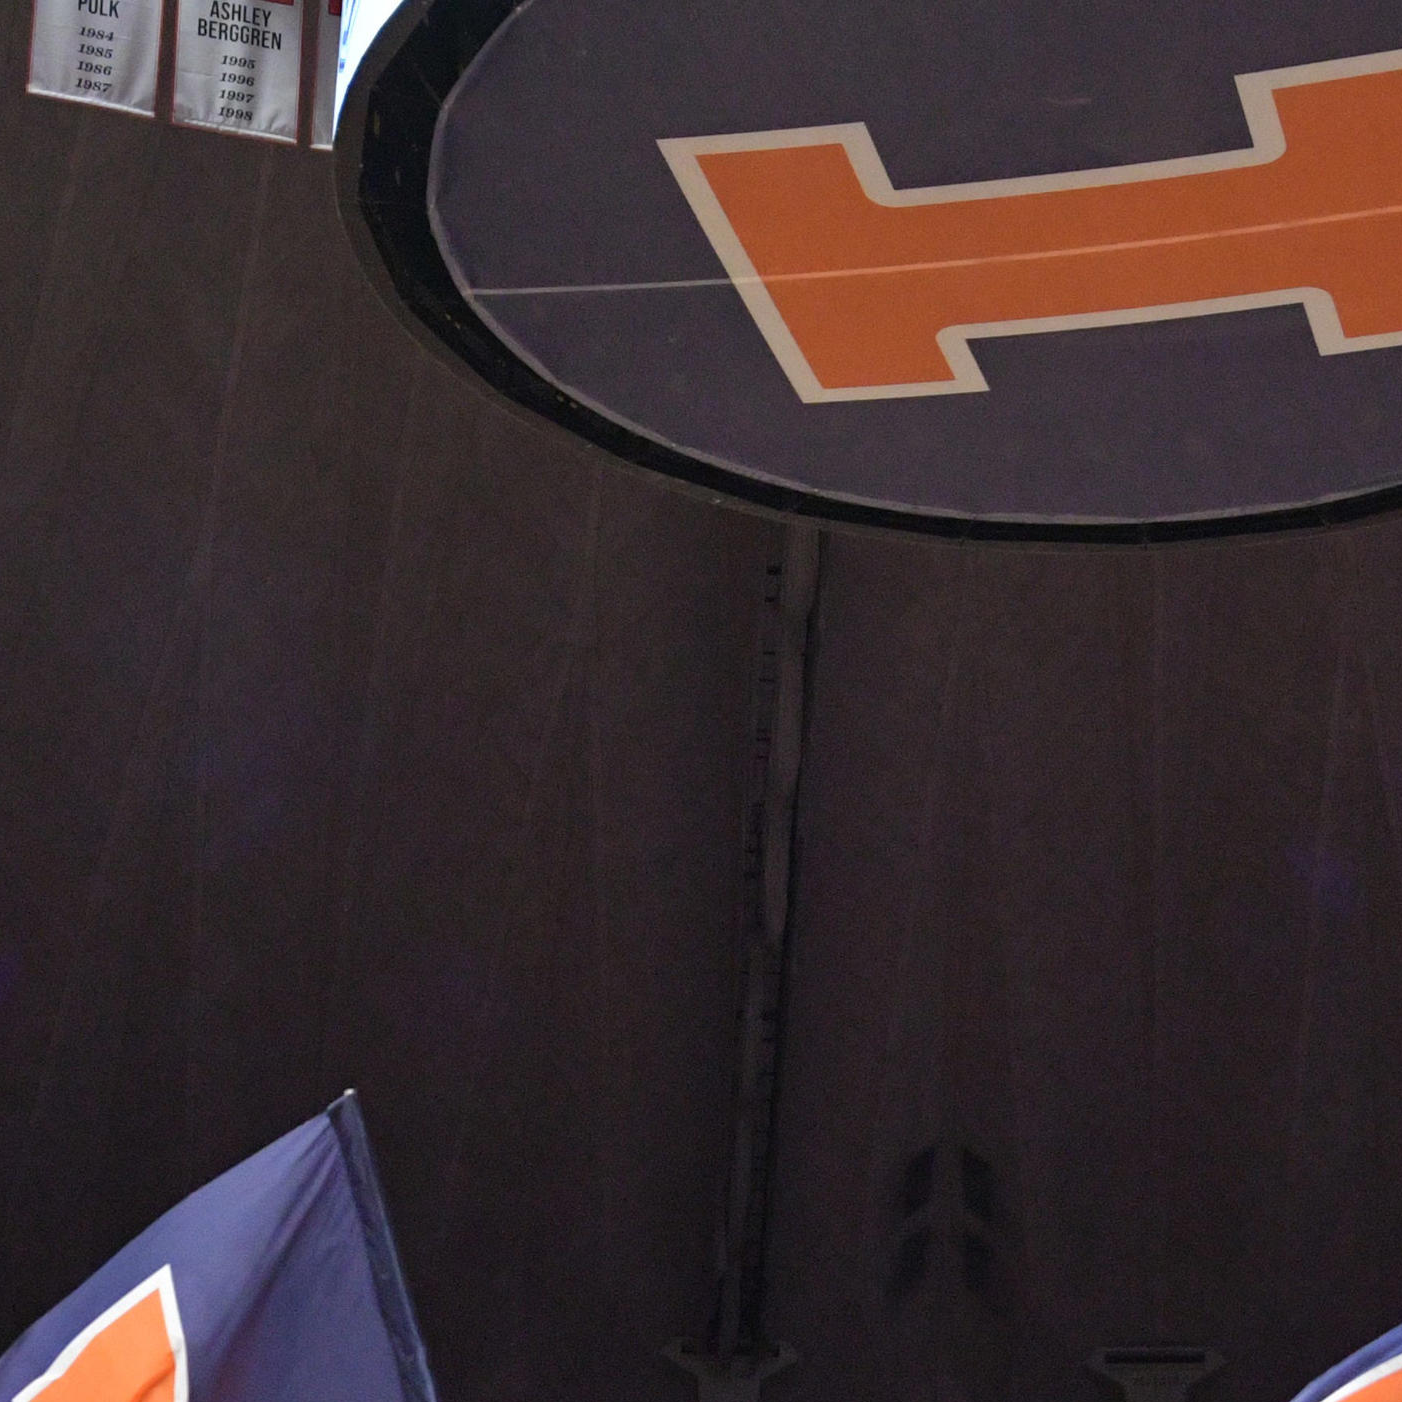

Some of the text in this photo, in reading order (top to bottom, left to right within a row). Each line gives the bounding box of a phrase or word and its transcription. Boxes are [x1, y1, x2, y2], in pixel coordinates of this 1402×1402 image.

[210, 1, 271, 27] ASHLEY
[79, 26, 114, 41] 1984
[198, 18, 282, 50] BERGGREN
[78, 43, 113, 59] 1985
[77, 61, 113, 76] 1986
[222, 55, 256, 69] 1995
[75, 78, 112, 93] 1987
[220, 73, 255, 87] 1996
[219, 90, 254, 103] 1997
[218, 107, 253, 121] 1998
